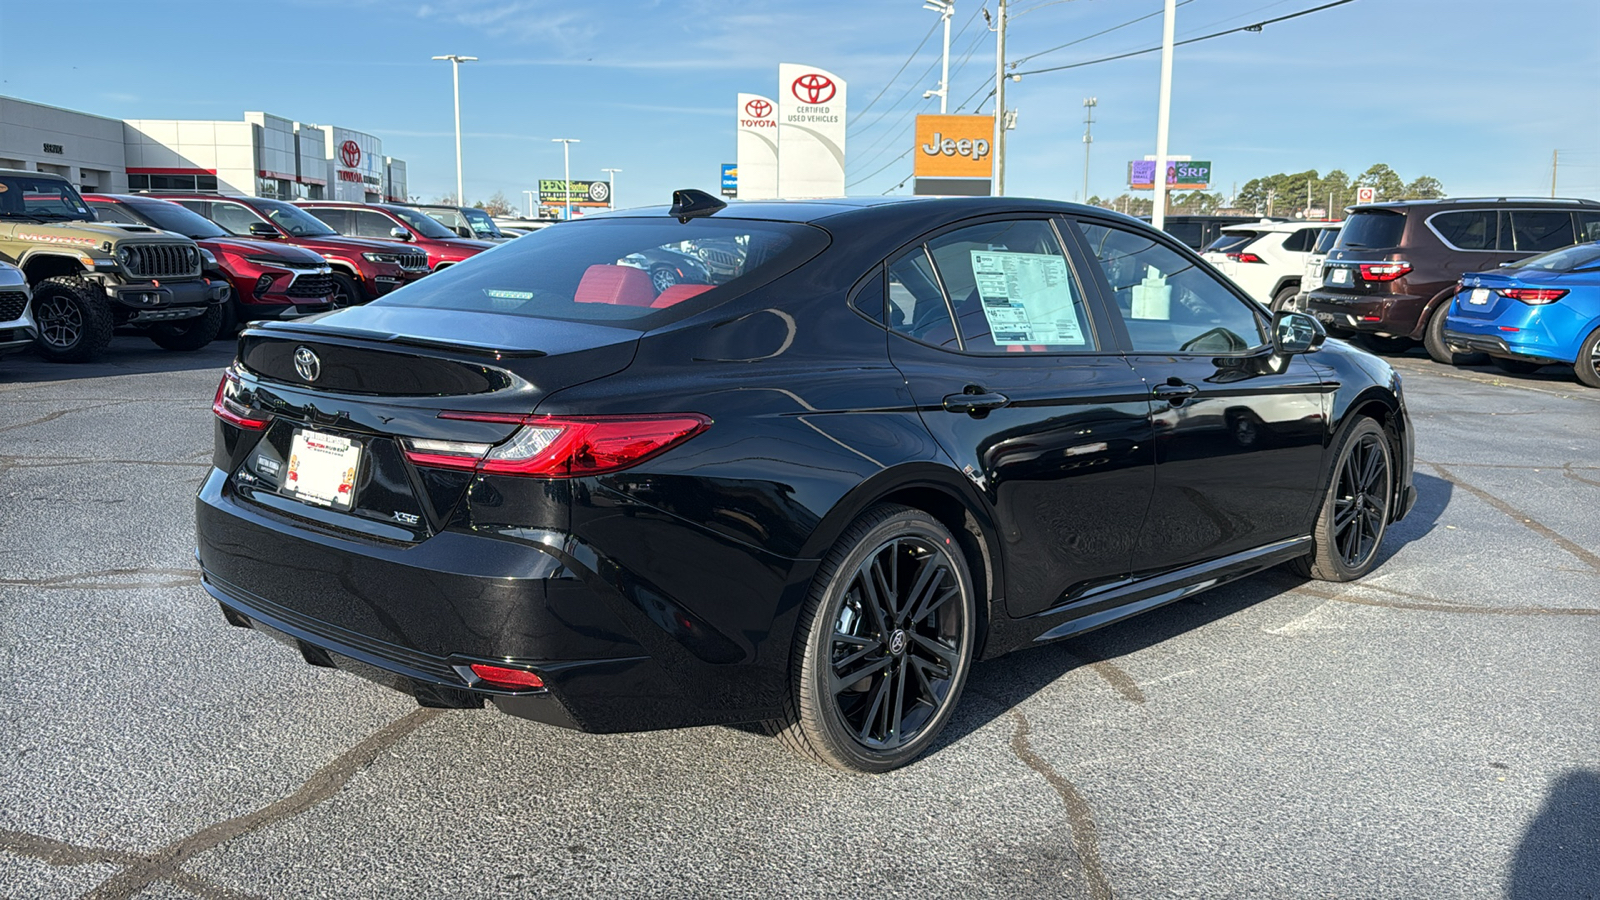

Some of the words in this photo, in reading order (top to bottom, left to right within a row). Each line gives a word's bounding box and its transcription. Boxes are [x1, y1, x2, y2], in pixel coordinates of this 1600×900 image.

[797, 106, 830, 114] CERTIFIED
[740, 119, 777, 128] TOYOTA
[807, 115, 839, 123] VEHICLES
[922, 132, 989, 160] Jeep
[338, 170, 363, 183] TOYOTA
[1178, 167, 1208, 177] SRP
[18, 233, 96, 246] MOJAVE
[325, 445, 345, 453] RUBEN
[391, 511, 420, 524] XSE
